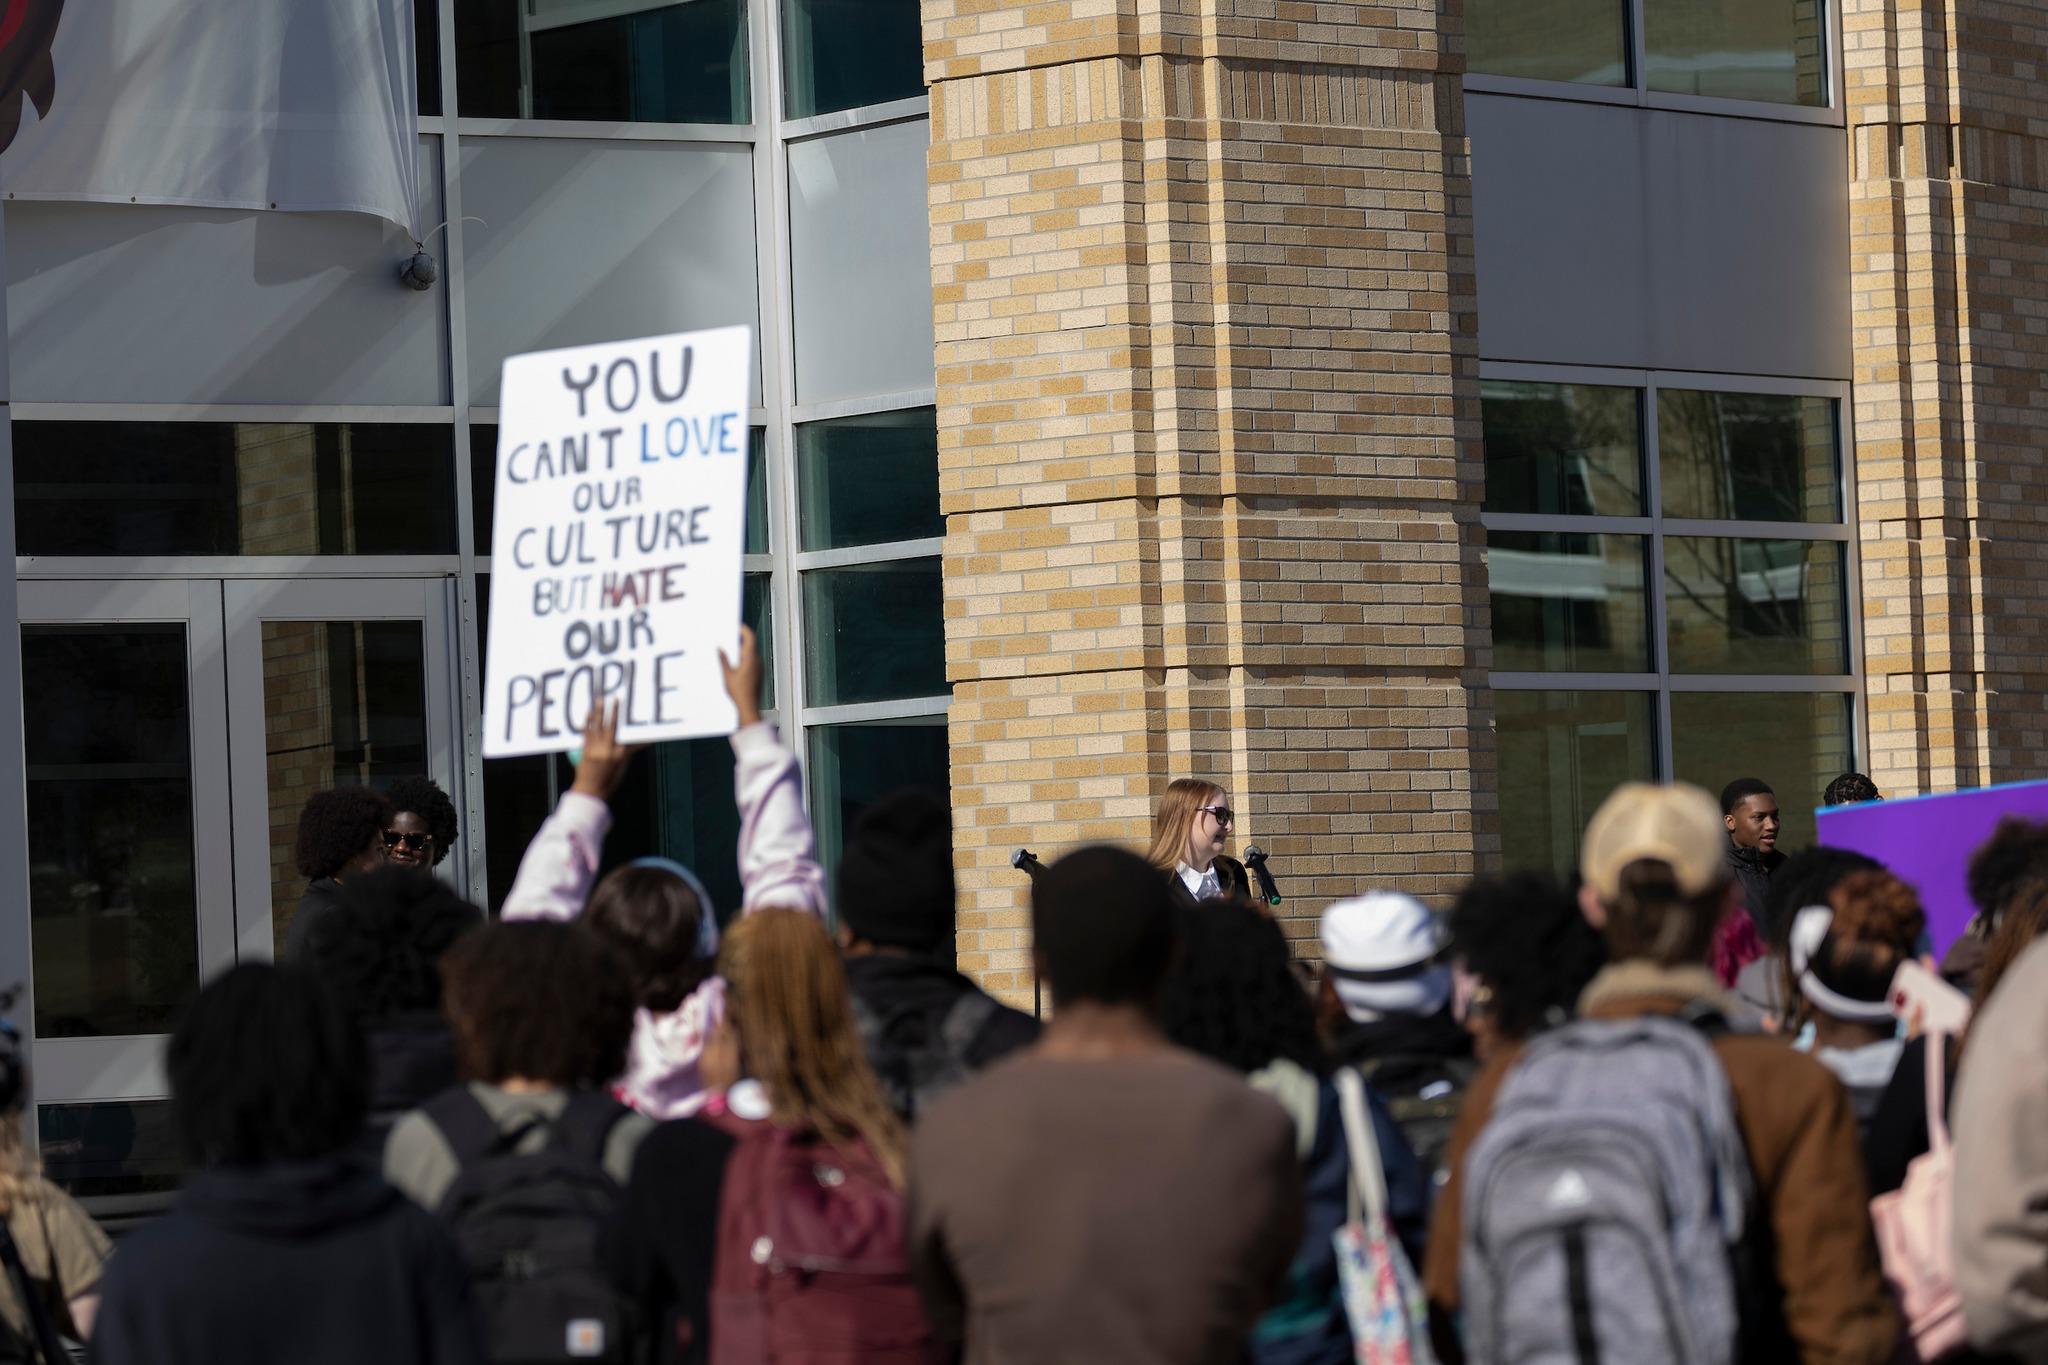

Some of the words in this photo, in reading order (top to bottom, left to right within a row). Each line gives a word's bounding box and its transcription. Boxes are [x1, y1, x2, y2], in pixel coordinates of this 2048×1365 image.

[562, 345, 693, 418] YOU
[640, 412, 739, 463] LOVE
[572, 475, 643, 513] OUR
[512, 505, 711, 569] CULTURE
[532, 573, 594, 617] BUT
[599, 563, 688, 611] HATE
[563, 609, 656, 661] OUR
[503, 649, 687, 742] PEOPLE
